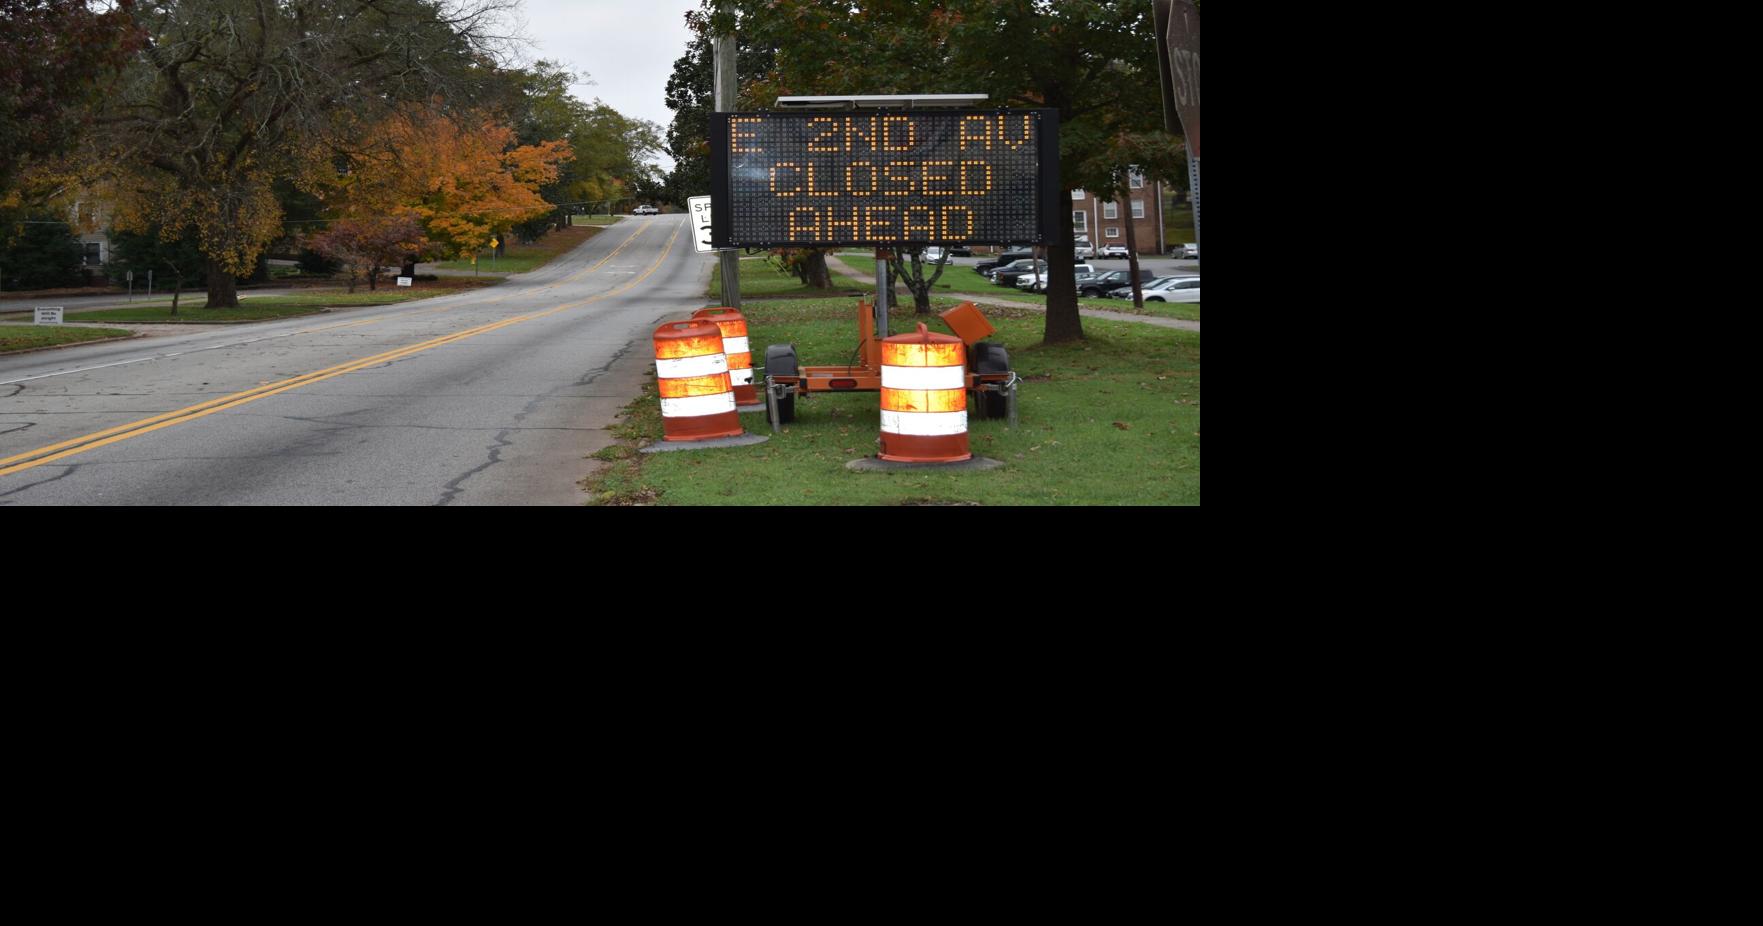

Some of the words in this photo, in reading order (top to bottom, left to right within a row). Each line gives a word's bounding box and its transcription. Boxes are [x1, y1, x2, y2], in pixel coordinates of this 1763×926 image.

[731, 117, 762, 152] E
[808, 116, 915, 151] 2ND
[960, 115, 1030, 150] AV
[770, 161, 992, 196] CLOSED
[789, 206, 973, 241] AHEAD
